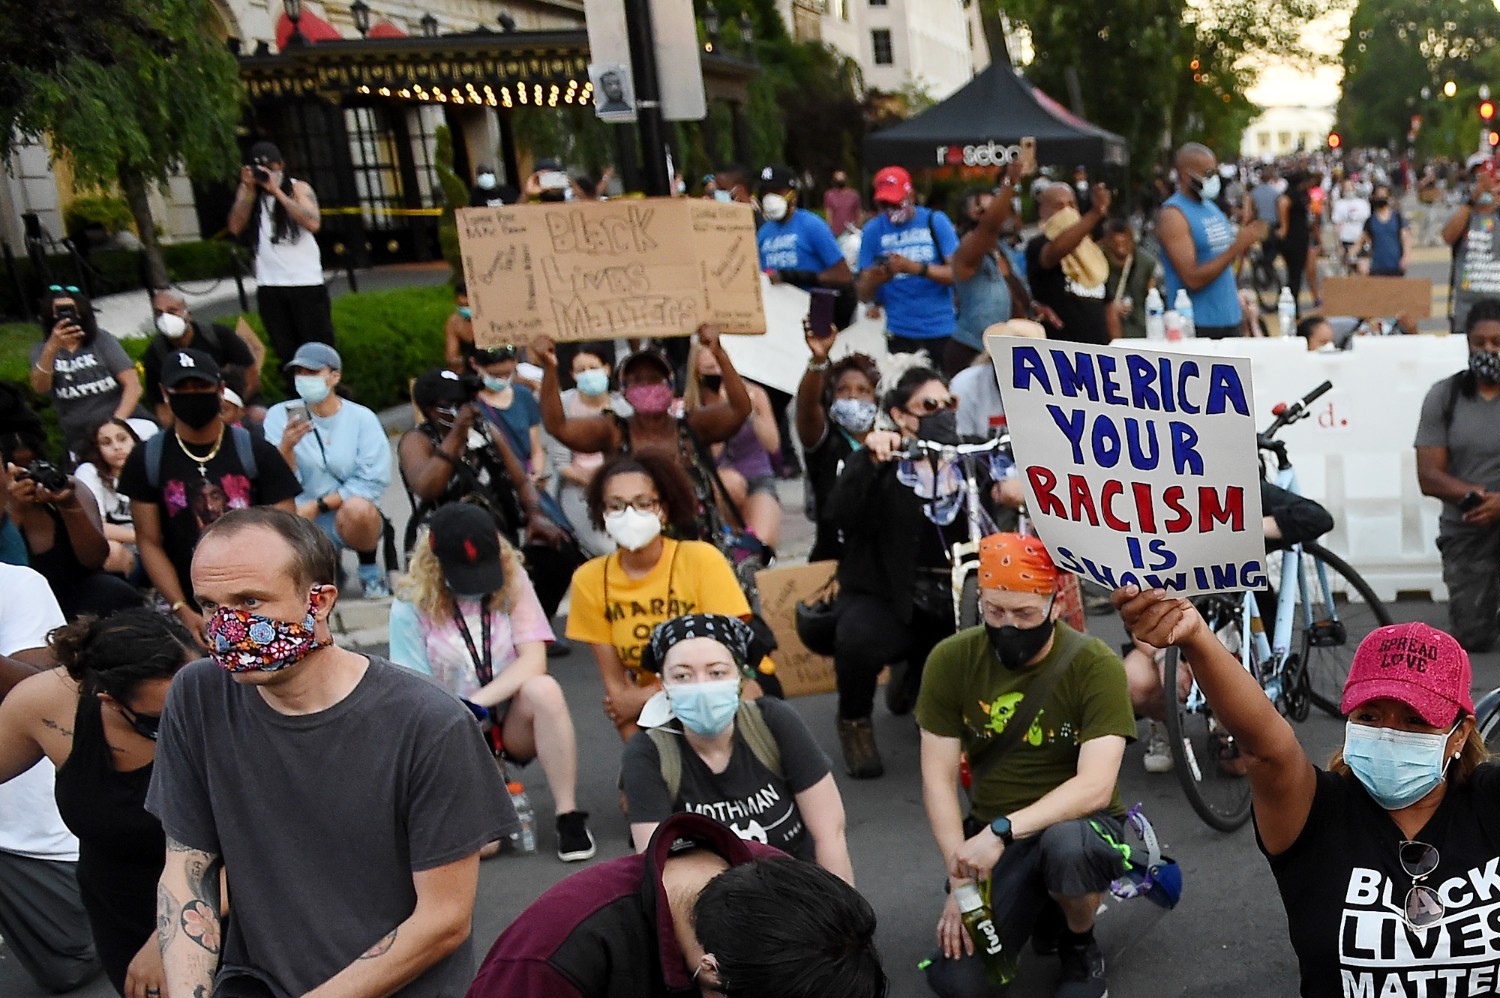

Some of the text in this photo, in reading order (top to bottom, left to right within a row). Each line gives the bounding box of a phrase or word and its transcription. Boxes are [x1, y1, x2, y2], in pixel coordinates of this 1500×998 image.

[54, 353, 98, 373] BLACK
[1011, 345, 1250, 417] AMERICA
[55, 375, 118, 399] MATTER
[1046, 404, 1204, 476] YOUR
[1026, 465, 1246, 534] RACISM
[1056, 546, 1267, 592] SHOWING
[1126, 536, 1177, 572] IS
[633, 621, 661, 640] O
[1380, 636, 1438, 662] SPREAD
[685, 783, 780, 822] MOTHMAN
[977, 919, 1003, 955] fuel
